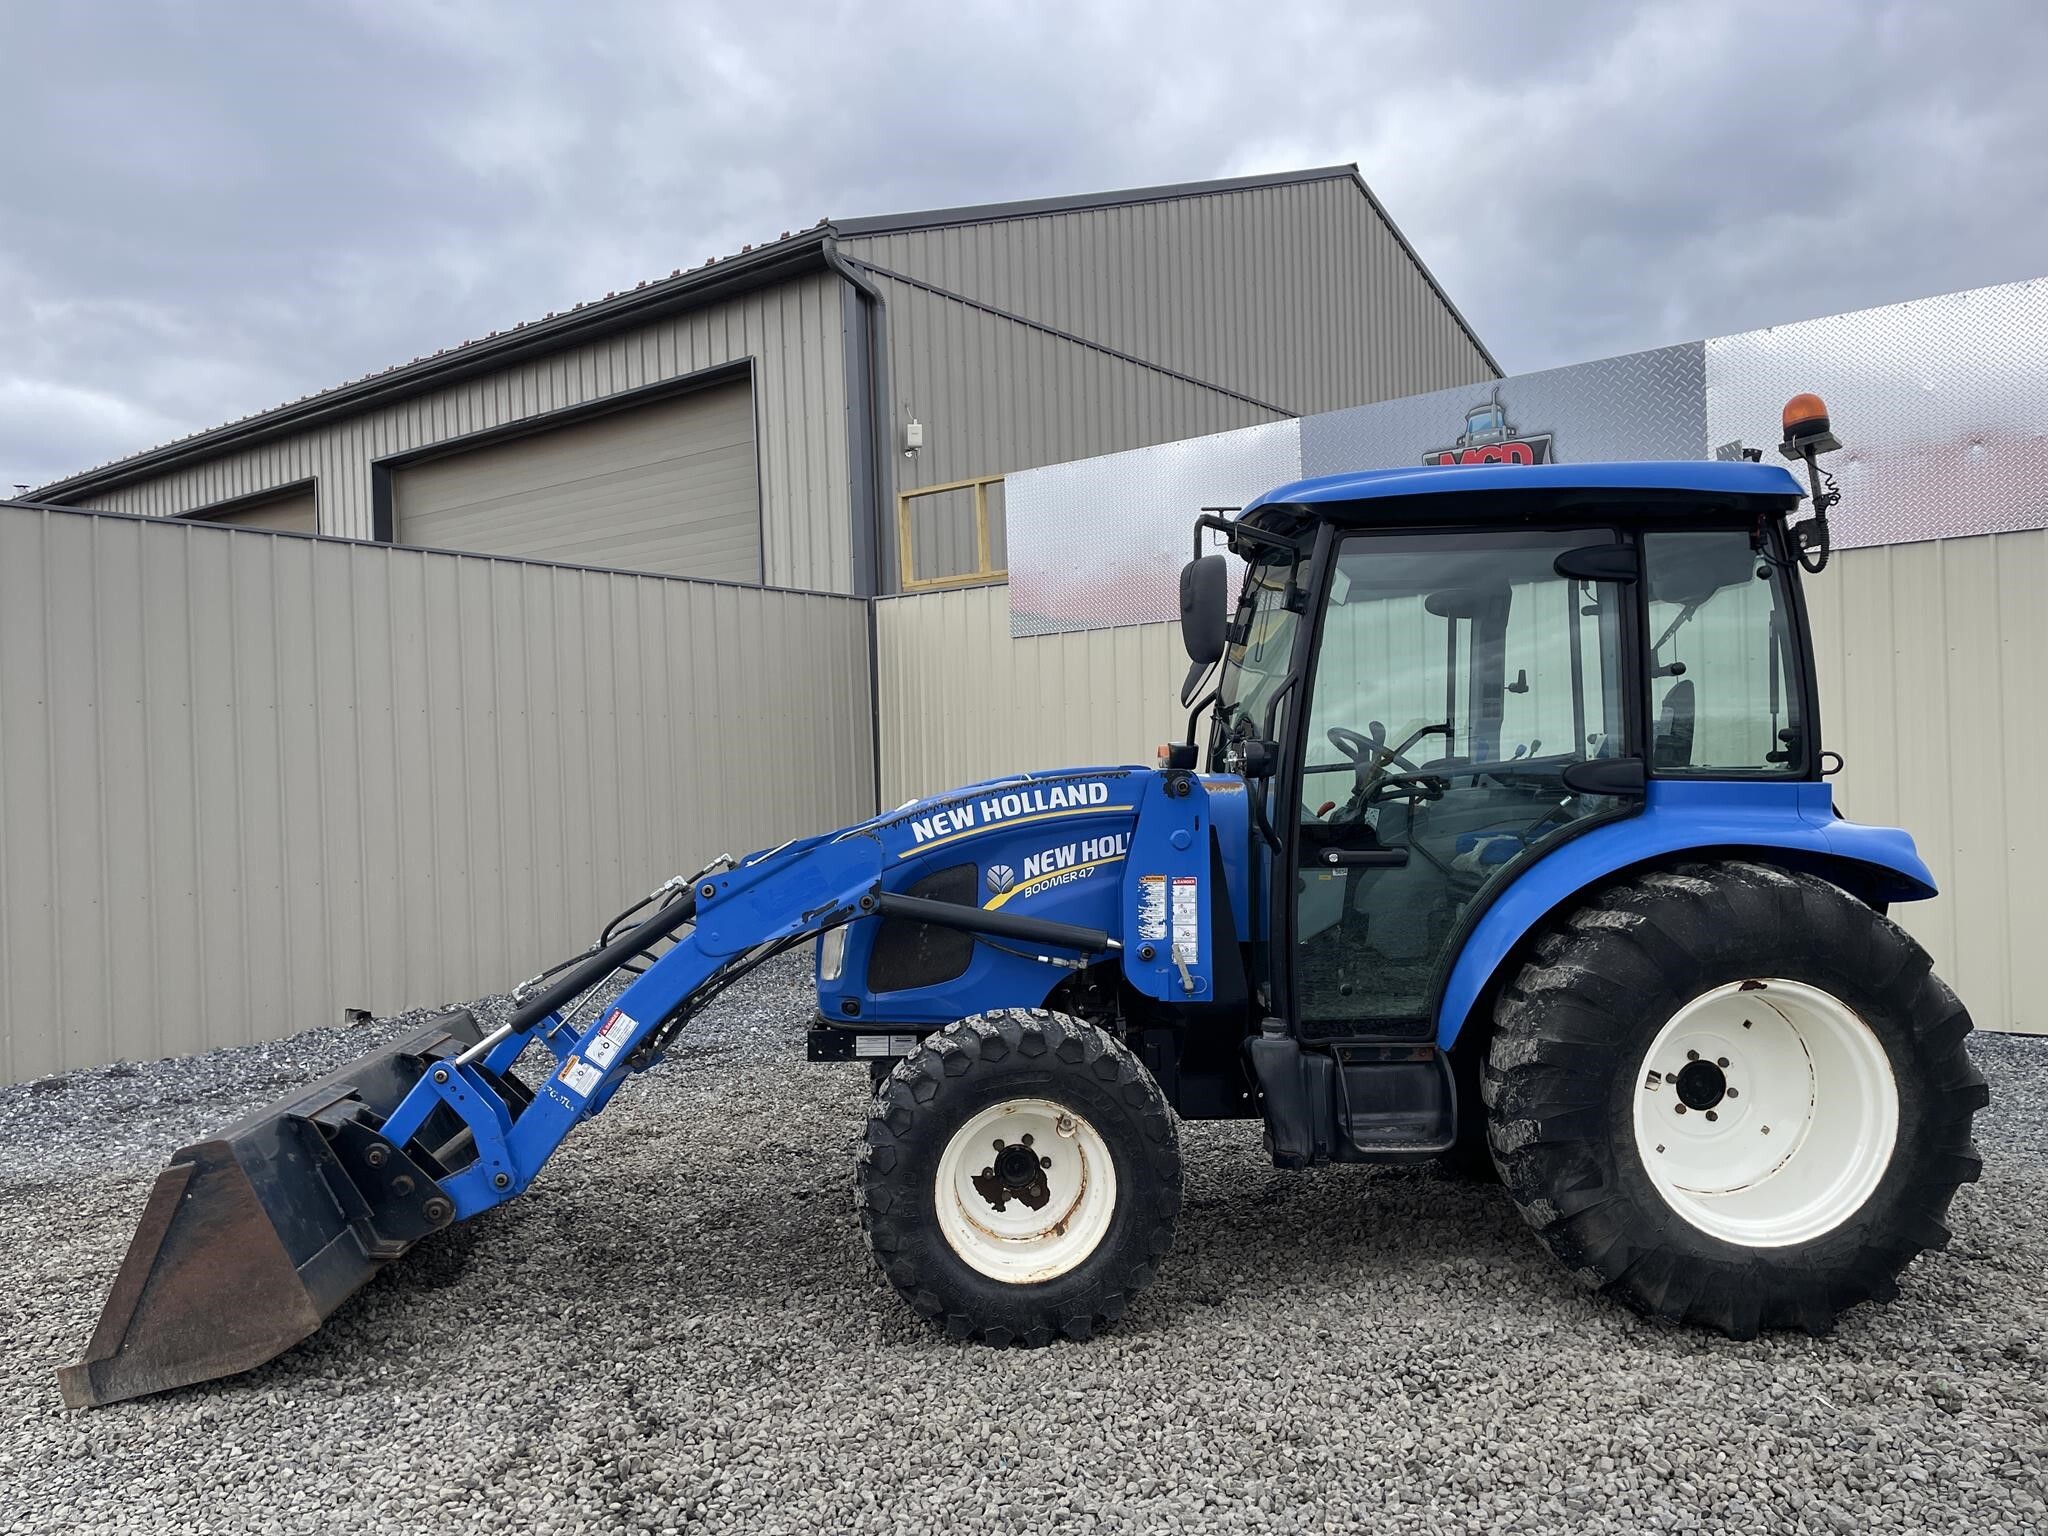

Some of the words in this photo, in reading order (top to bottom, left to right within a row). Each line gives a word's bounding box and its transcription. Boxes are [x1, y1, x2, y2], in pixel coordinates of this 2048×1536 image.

[911, 804, 975, 843] NEW
[979, 781, 1108, 823] HOLLAND
[1023, 843, 1076, 880] NEW
[1082, 831, 1131, 862] HOL
[1024, 871, 1078, 899] BOOMER
[1078, 866, 1095, 879] 47
